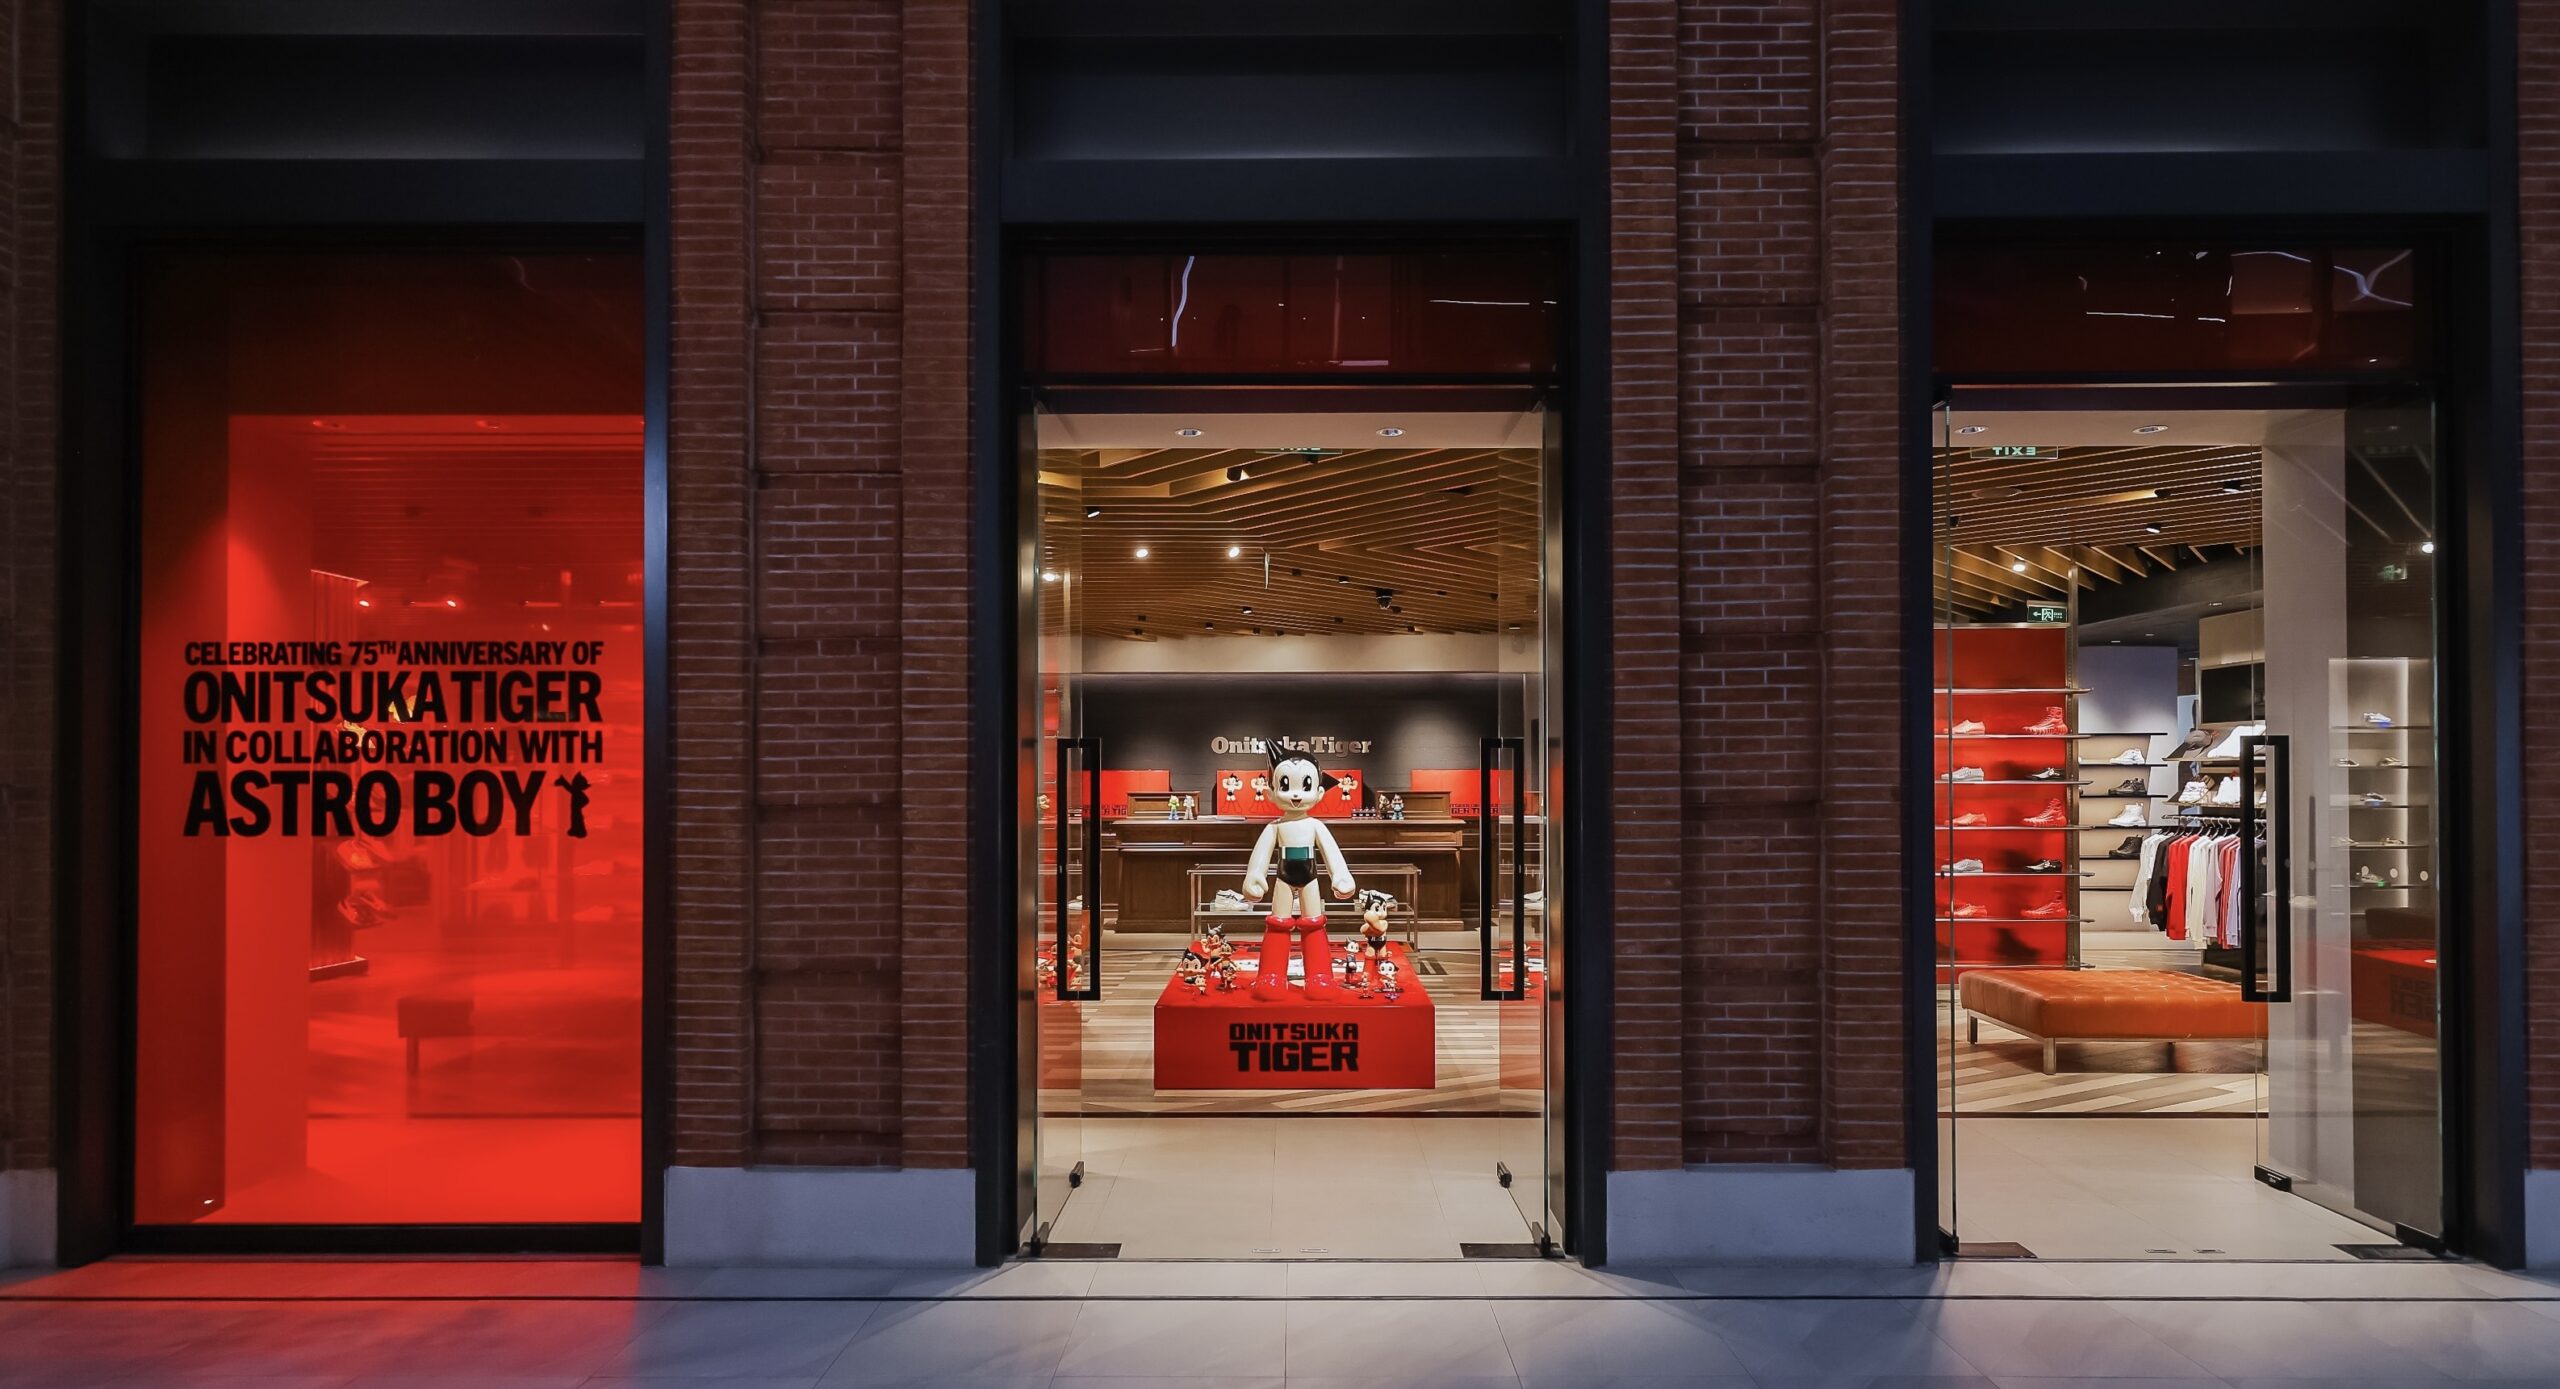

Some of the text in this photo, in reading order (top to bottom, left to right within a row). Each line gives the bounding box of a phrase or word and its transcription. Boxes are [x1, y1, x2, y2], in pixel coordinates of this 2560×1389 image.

[185, 640, 604, 666] CELEBRATING 75TH ANNIVERSARY OF
[183, 670, 603, 724] ONITSUKA TIGER
[183, 730, 603, 765] IN COLLABORATION WITH
[183, 769, 547, 838] ASTRO BOY
[1229, 1023, 1359, 1041] ONITSUKA
[1229, 1042, 1359, 1072] TIGER
